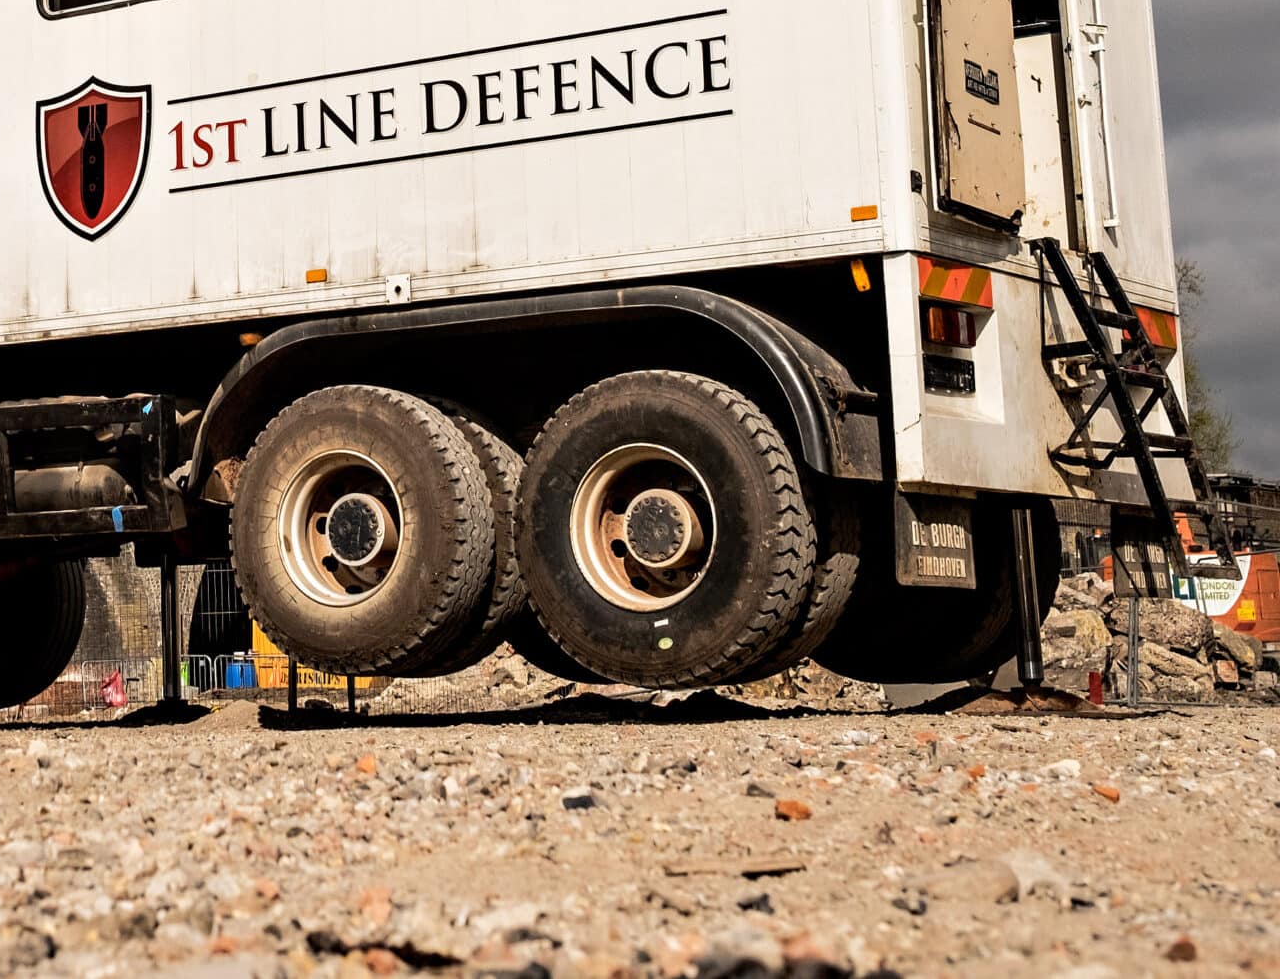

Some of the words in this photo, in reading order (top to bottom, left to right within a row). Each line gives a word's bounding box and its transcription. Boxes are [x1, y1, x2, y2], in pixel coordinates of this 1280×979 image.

[168, 118, 247, 171] 1ST
[261, 87, 398, 158] LINE
[420, 34, 731, 135] DEFENCE
[912, 520, 928, 547] DE
[917, 556, 967, 578] EINDHOVEN
[1198, 591, 1230, 600] LMITED
